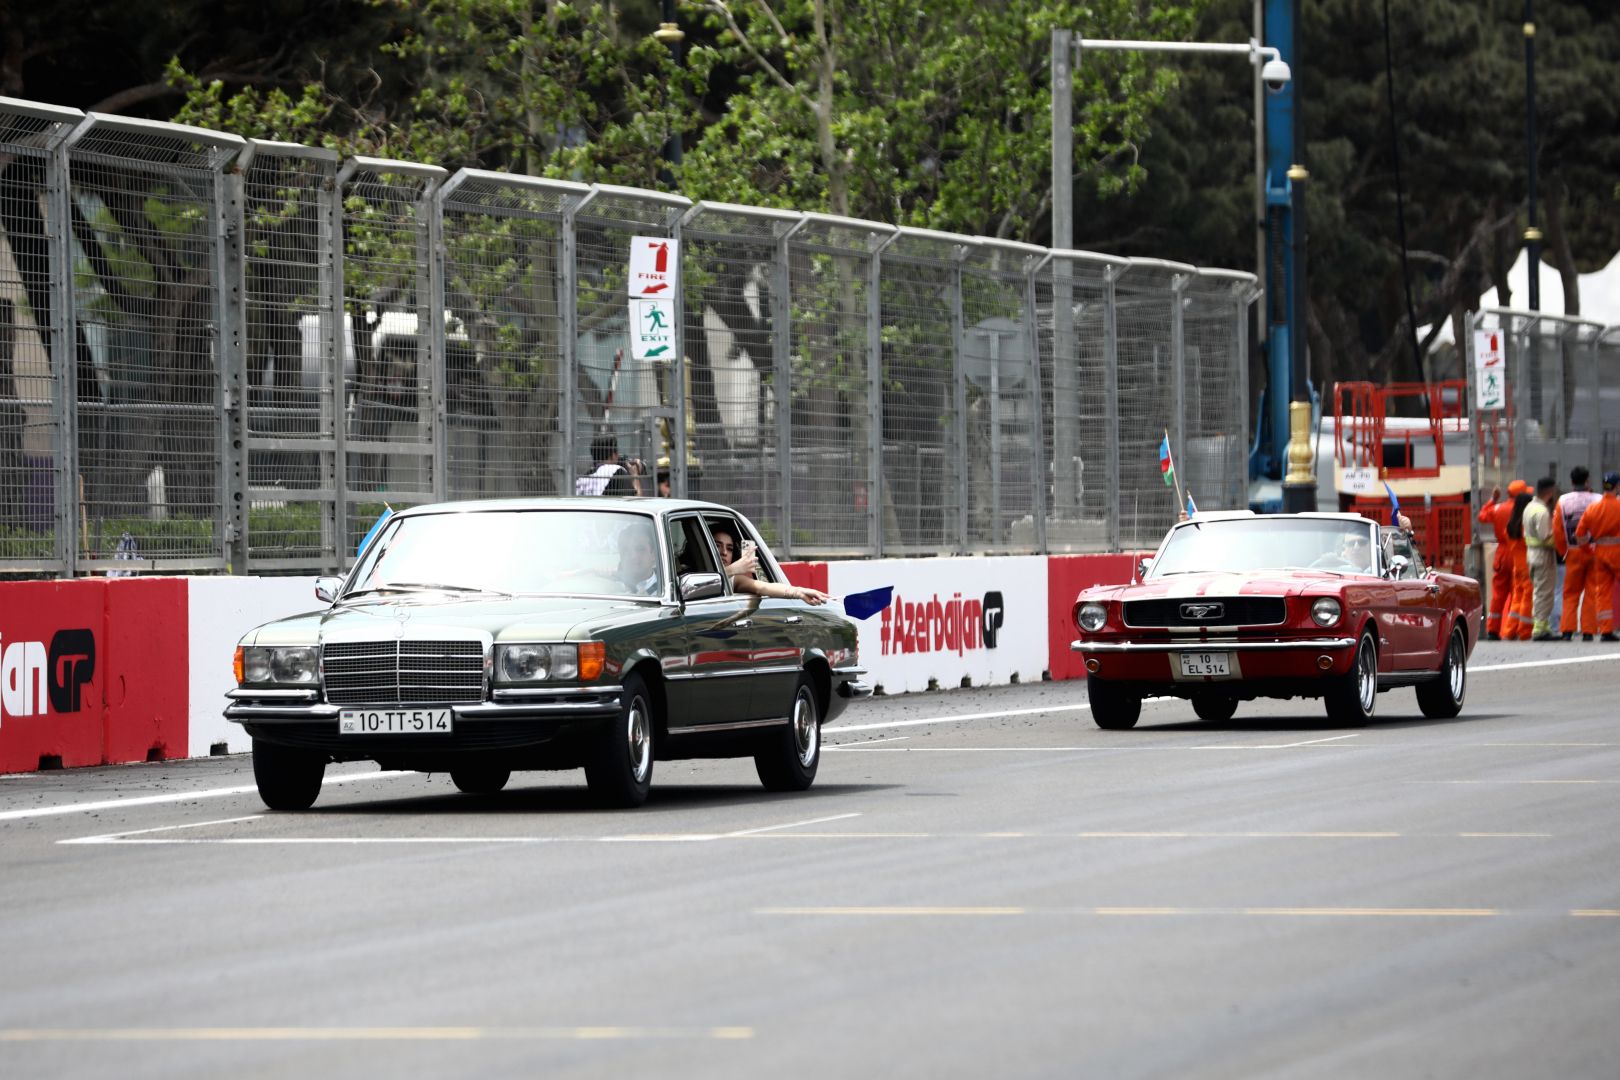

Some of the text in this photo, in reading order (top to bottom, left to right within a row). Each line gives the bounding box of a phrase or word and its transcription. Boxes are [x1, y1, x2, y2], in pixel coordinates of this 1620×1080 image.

[638, 272, 667, 281] FIRE
[880, 591, 1004, 657] #AzerbaijanGP
[1199, 654, 1211, 664] 10
[1188, 664, 1225, 674] EL 514
[0, 628, 96, 729] anGP
